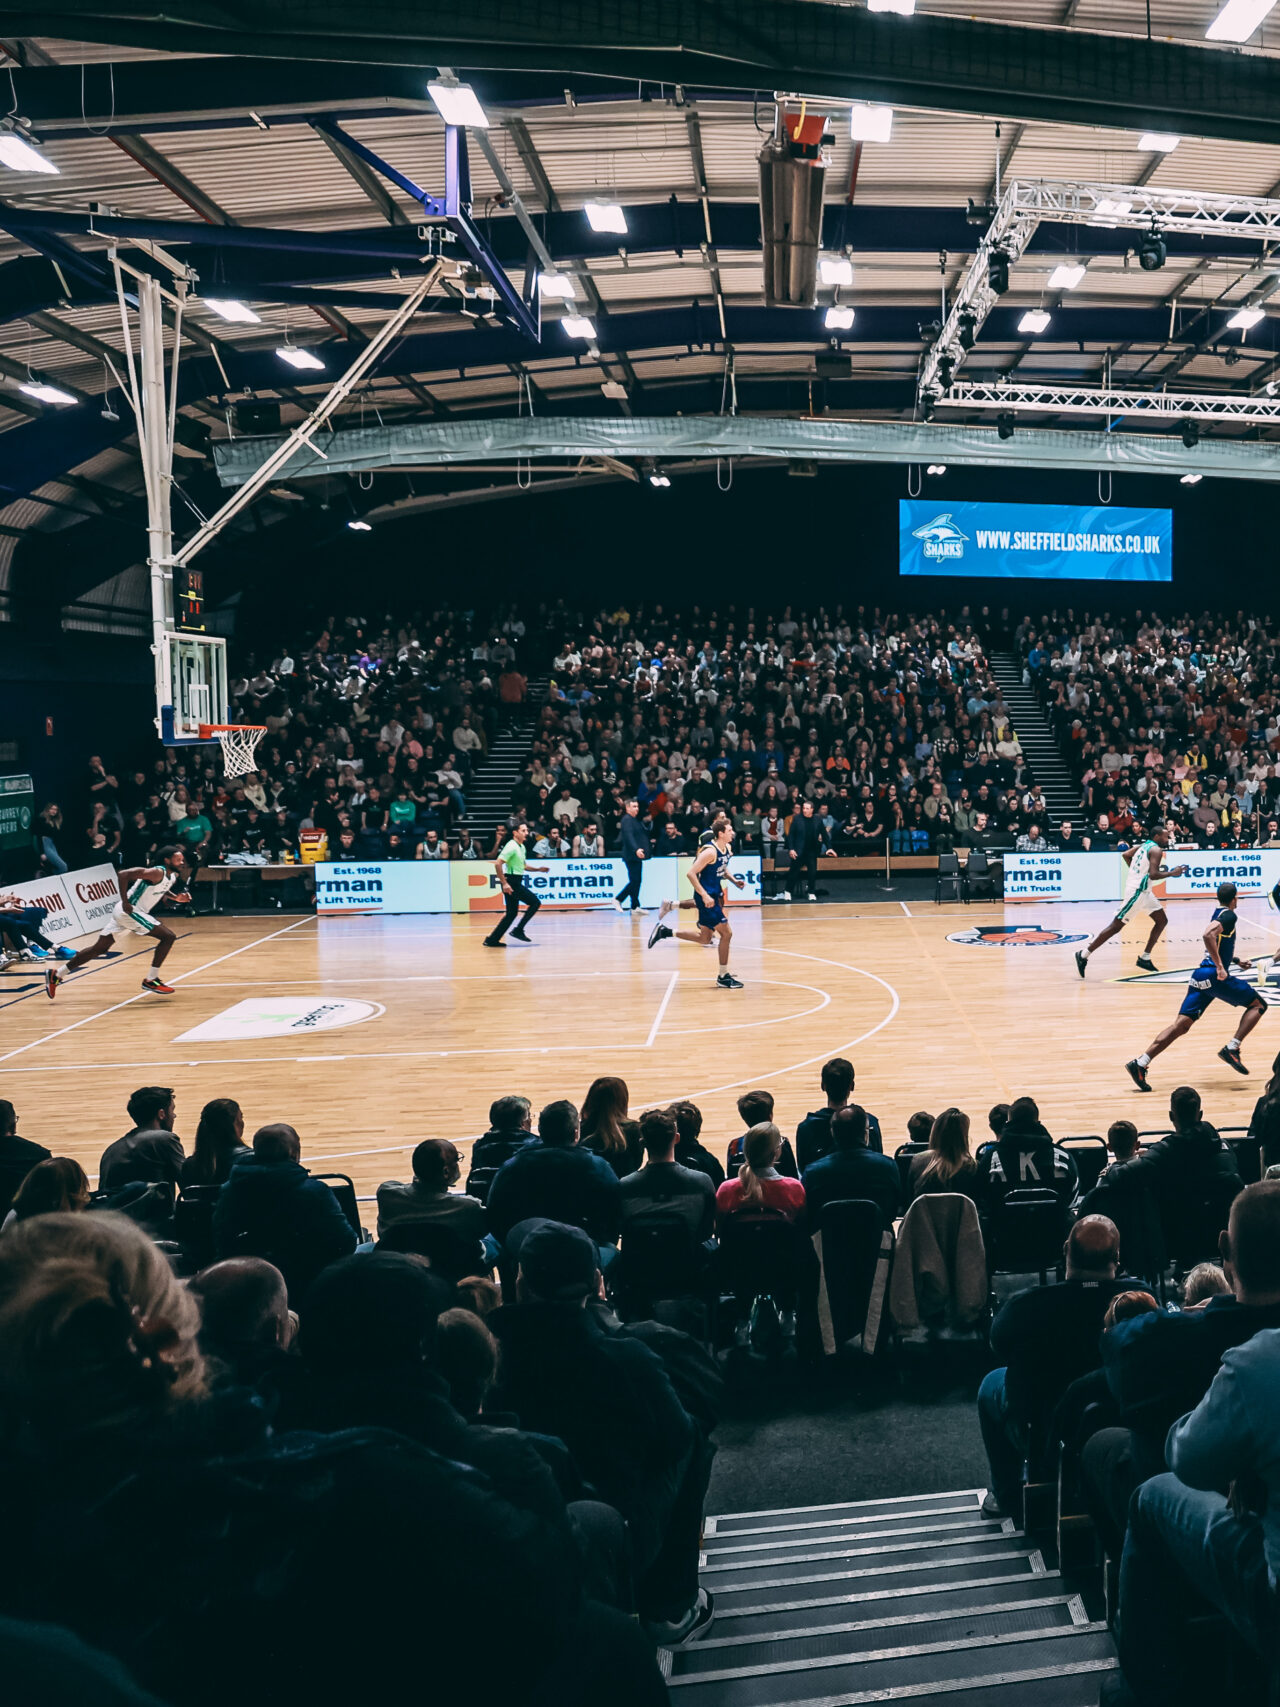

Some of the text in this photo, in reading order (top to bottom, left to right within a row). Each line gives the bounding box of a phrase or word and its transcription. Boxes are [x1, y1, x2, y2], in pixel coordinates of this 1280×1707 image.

[976, 530, 1160, 554] WWW.SHEFFIELDSHARKS.CO.UK
[925, 542, 962, 557] SHARKS
[333, 867, 355, 875] Est.
[590, 863, 613, 871] 1968
[490, 874, 614, 888] Pterman
[1004, 869, 1062, 881] rman
[75, 878, 118, 904] Canon
[316, 879, 383, 892] rman
[325, 896, 343, 904] Lift
[347, 896, 383, 904] Trucks
[85, 906, 105, 921] CANON
[47, 917, 73, 932] MEDICAL
[988, 1146, 1070, 1183] AKE
